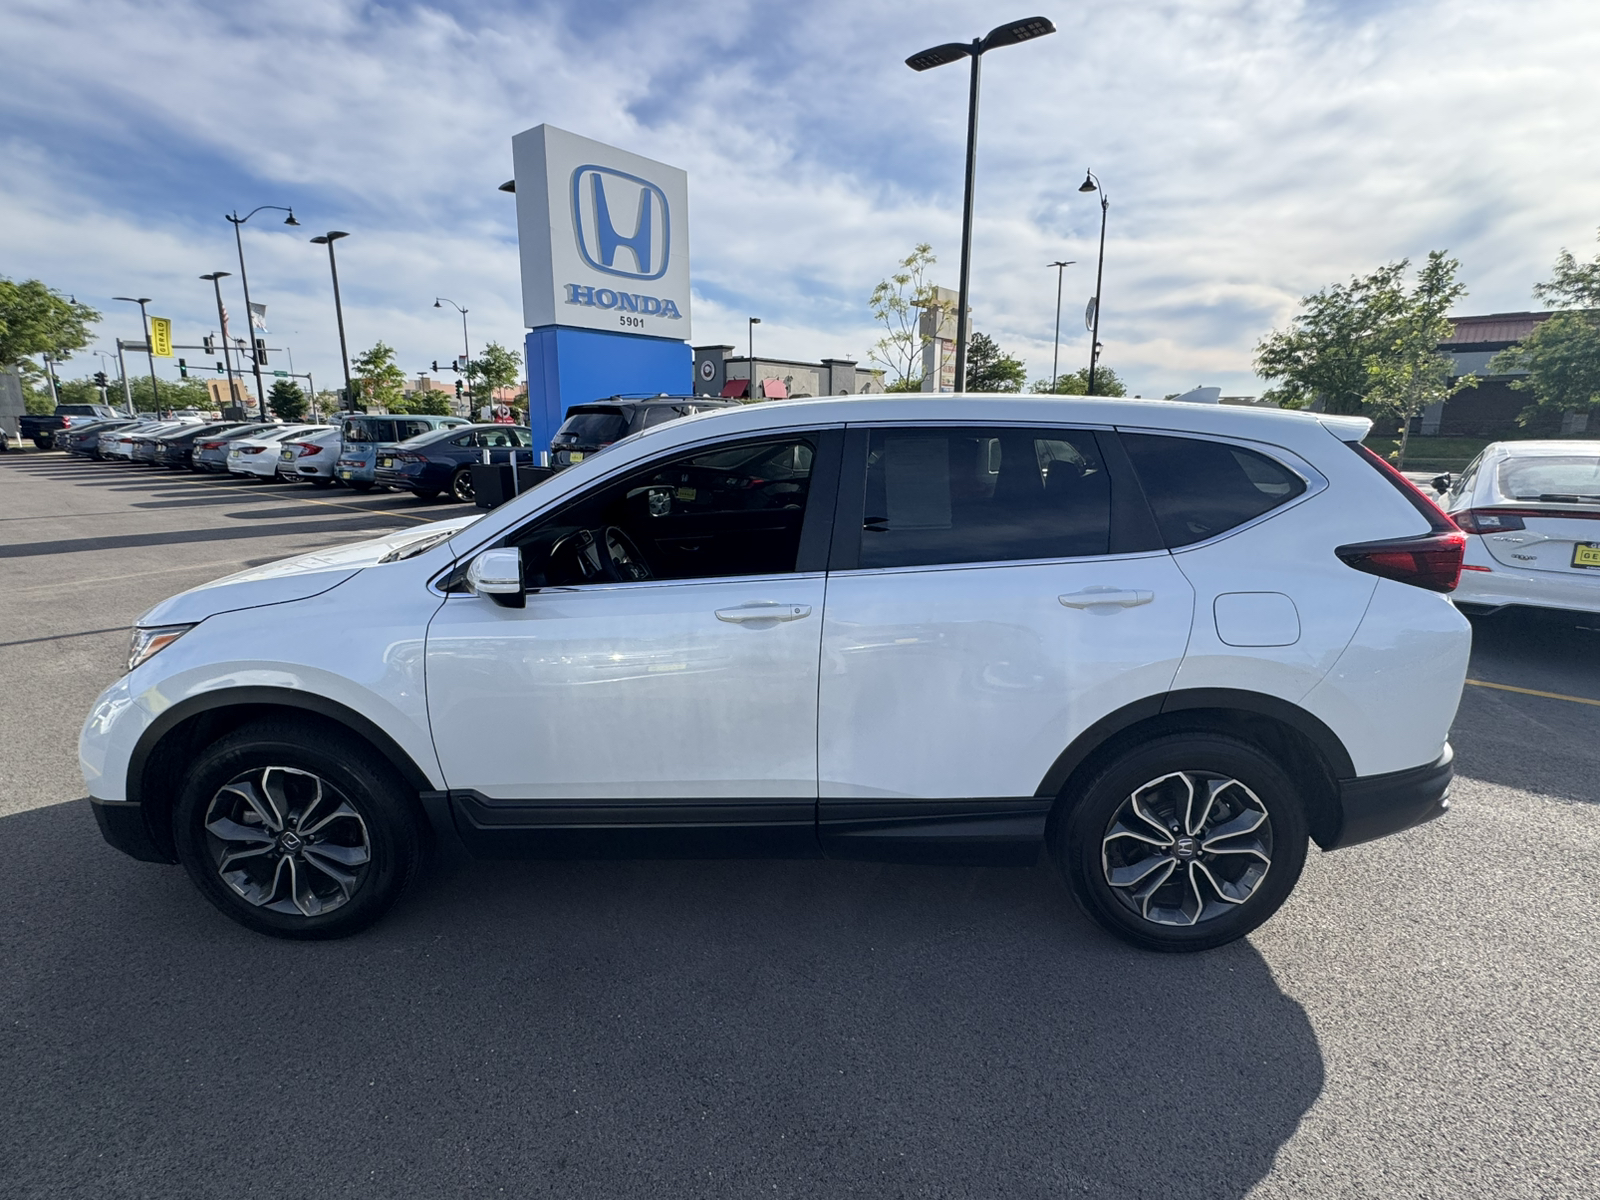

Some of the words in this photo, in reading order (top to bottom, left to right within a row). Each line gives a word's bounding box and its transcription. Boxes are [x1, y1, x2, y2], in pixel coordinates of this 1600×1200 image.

[564, 283, 682, 320] HONDA
[619, 315, 645, 328] 5901
[157, 322, 166, 353] GERALD
